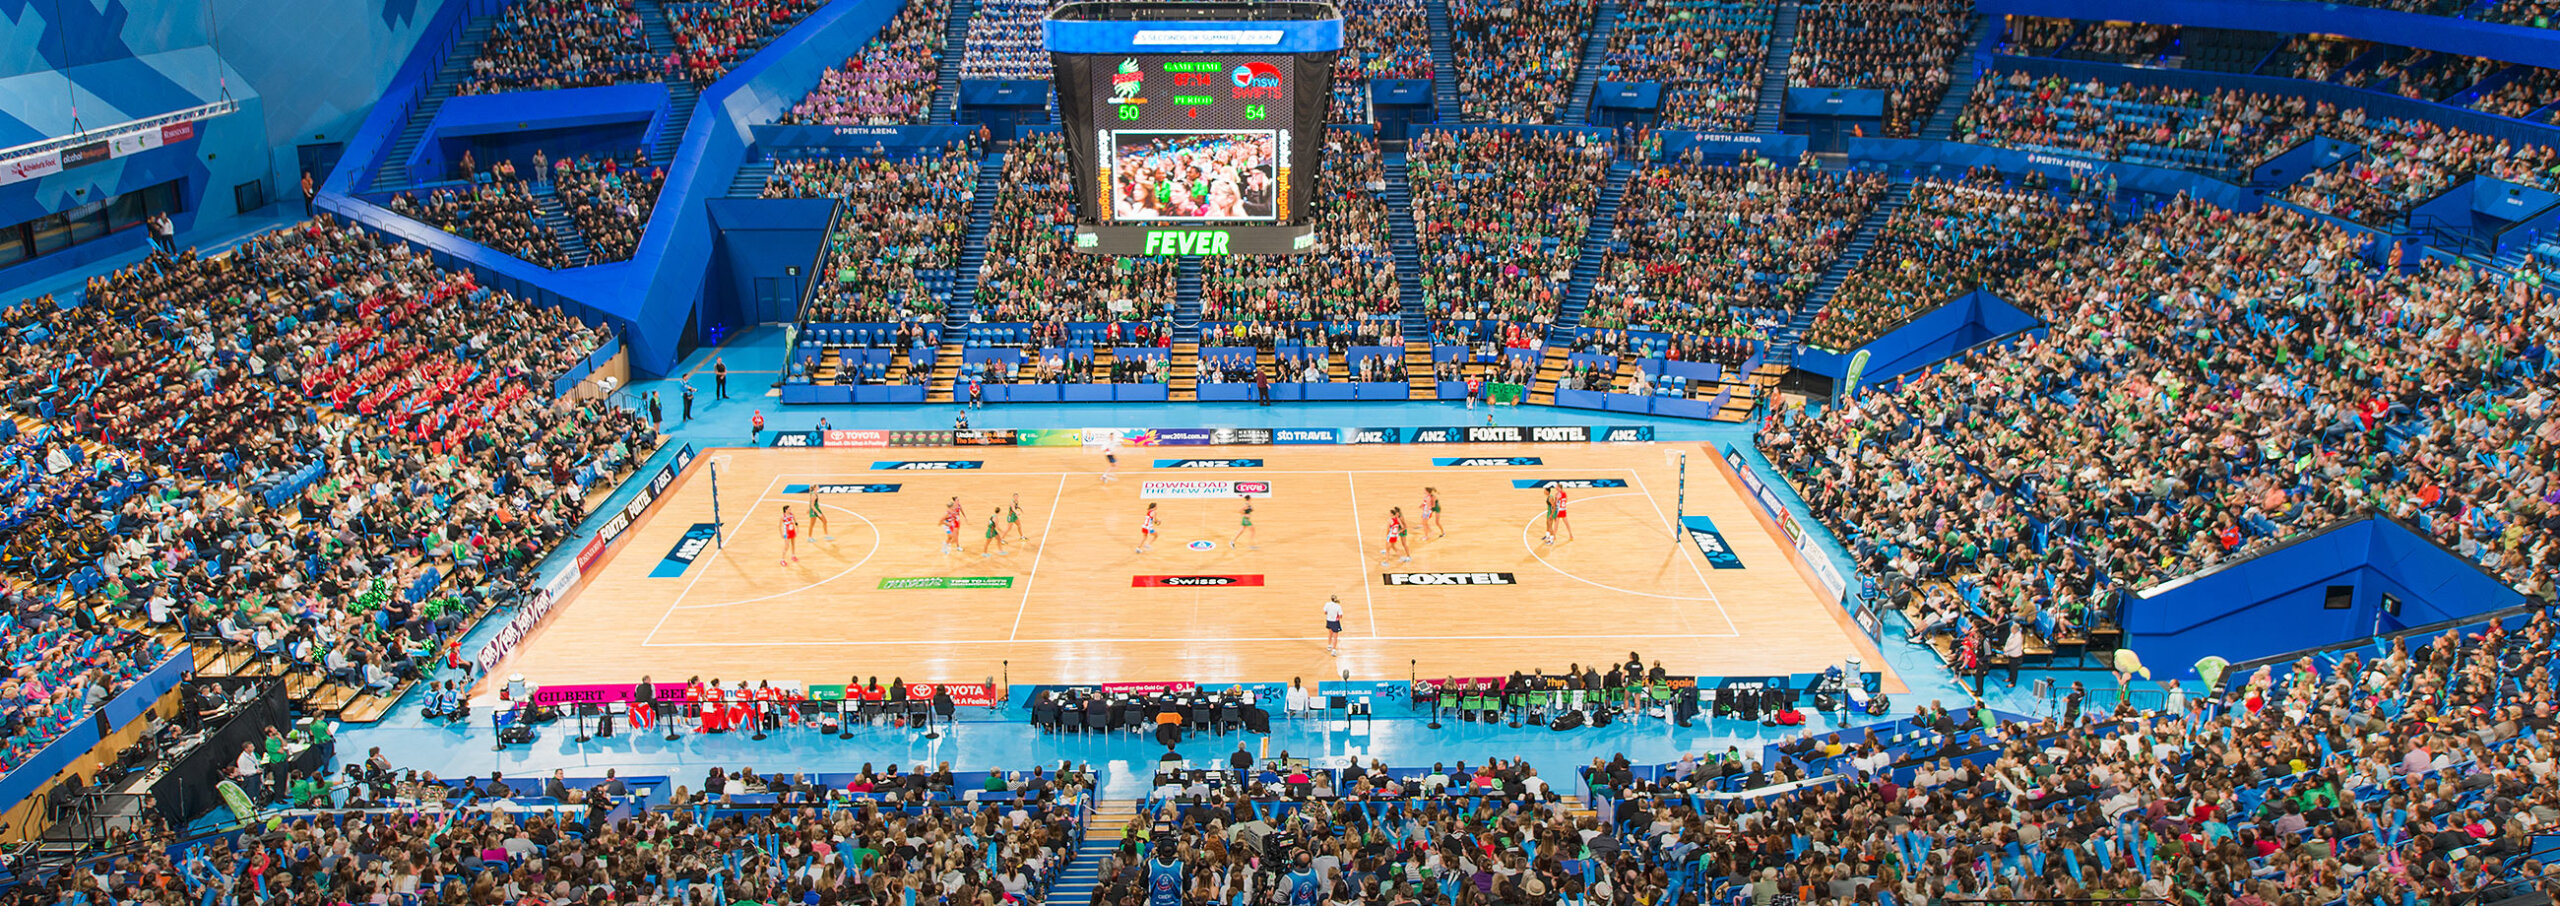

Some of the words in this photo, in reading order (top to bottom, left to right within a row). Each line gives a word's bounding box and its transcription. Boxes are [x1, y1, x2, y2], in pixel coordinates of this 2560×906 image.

[1173, 95, 1213, 105] PERIOD
[1118, 104, 1140, 121] 50
[1188, 107, 1197, 119] 4
[1245, 104, 1266, 121] 54
[2036, 155, 2063, 165] PERTH
[2064, 160, 2092, 169] ARENA
[1144, 230, 1231, 256] FEVER
[1276, 430, 1294, 441] sta
[1294, 431, 1332, 441] TRAVEL
[1355, 431, 1382, 442] ANZ
[1417, 431, 1446, 442] ANZ
[1469, 427, 1521, 441] FOXTEL
[1533, 427, 1586, 441] FOXTEL
[1608, 430, 1637, 441] ANZ
[777, 435, 806, 446] ANZ
[896, 462, 949, 470] ANZ
[1181, 460, 1230, 468] ANZ
[817, 485, 865, 493] ANZ
[627, 489, 652, 519] FOXTEL
[599, 512, 629, 544] FOXTEL
[1691, 531, 1724, 553] ANZ
[676, 538, 709, 561] ANZ
[1168, 577, 1228, 585] Swisse
[1390, 573, 1509, 585] FOXTEL
[538, 690, 605, 702] GILBERT
